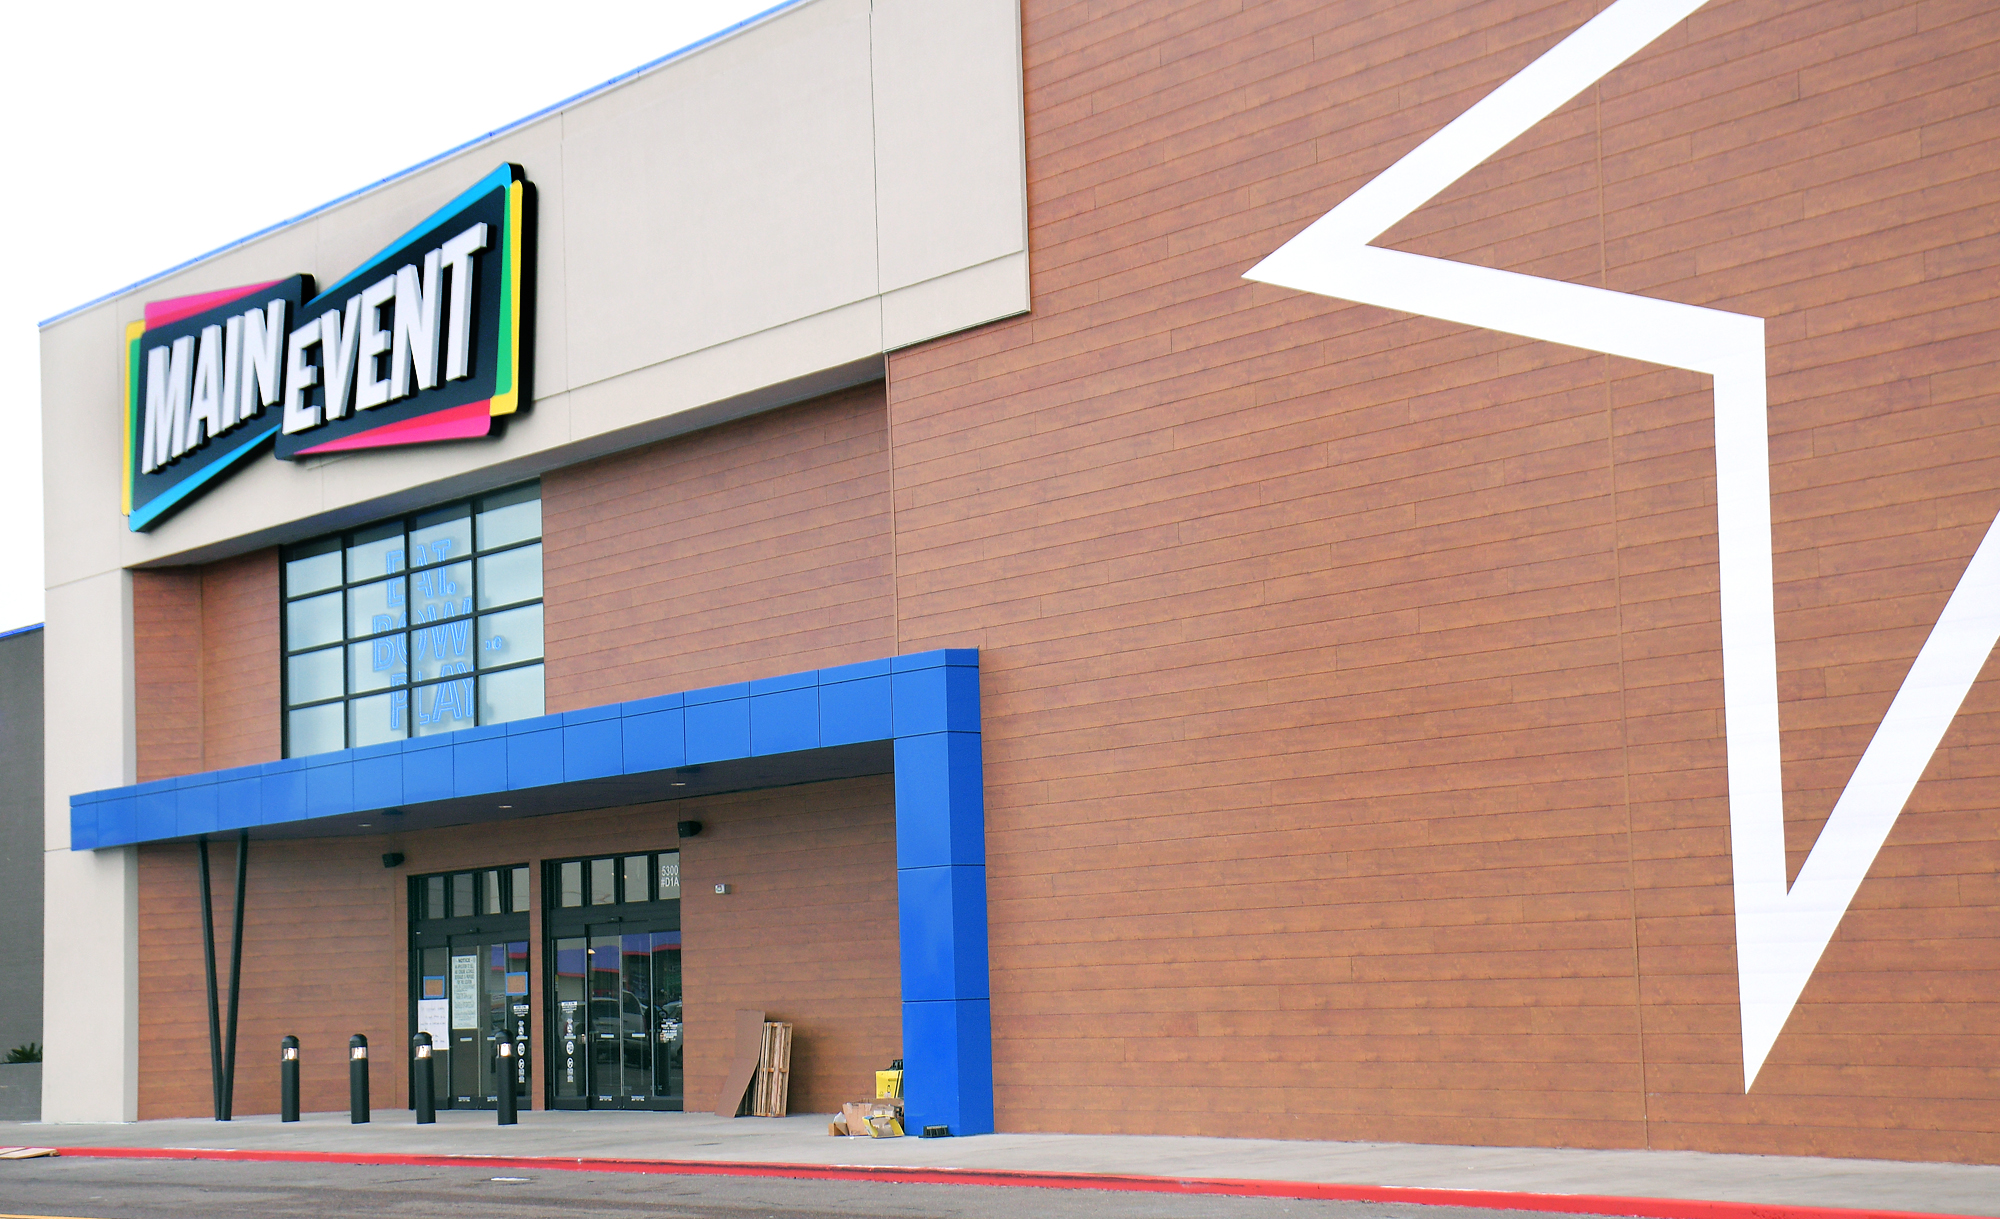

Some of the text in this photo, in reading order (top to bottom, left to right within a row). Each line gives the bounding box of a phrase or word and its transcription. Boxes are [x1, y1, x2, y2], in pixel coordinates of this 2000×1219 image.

[282, 222, 488, 435] EVENT
[142, 298, 286, 474] MAIN
[660, 876, 680, 888] #D1A
[661, 864, 679, 877] 5300
